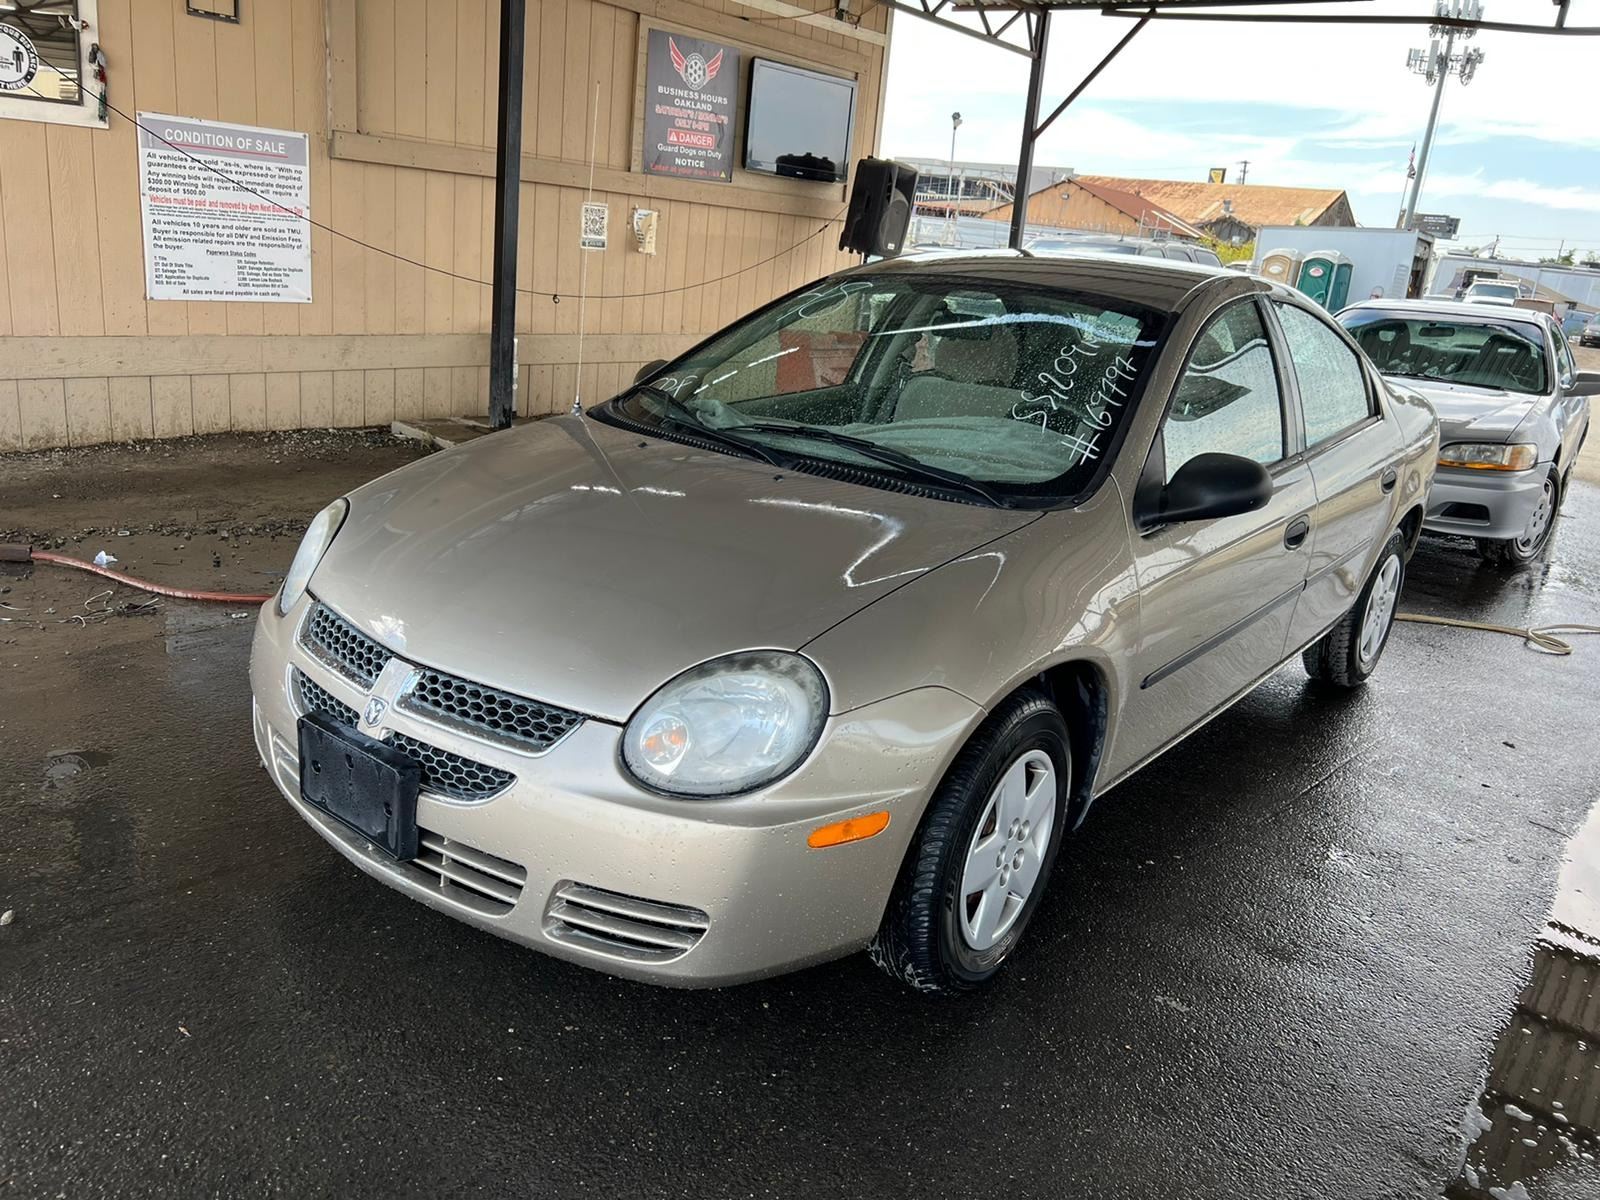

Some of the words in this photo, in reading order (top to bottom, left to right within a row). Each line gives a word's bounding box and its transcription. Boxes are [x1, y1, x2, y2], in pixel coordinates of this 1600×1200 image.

[658, 86, 699, 100] BUSINESS
[700, 93, 728, 104] HOURS
[674, 98, 712, 111] OAKLAND
[165, 128, 233, 148] CONDITION
[237, 138, 252, 149] OF
[256, 140, 285, 153] SALE
[679, 132, 713, 146] DANGER
[159, 154, 188, 162] vehicles
[657, 143, 679, 152] Guard
[680, 146, 696, 156] Dogs
[707, 150, 722, 160] Duty
[147, 161, 187, 170] guarantees
[235, 170, 269, 178] expressed
[675, 158, 705, 168] NOTICE
[173, 180, 199, 189] Winning
[180, 230, 215, 238] responsible
[259, 242, 295, 250] responsibility
